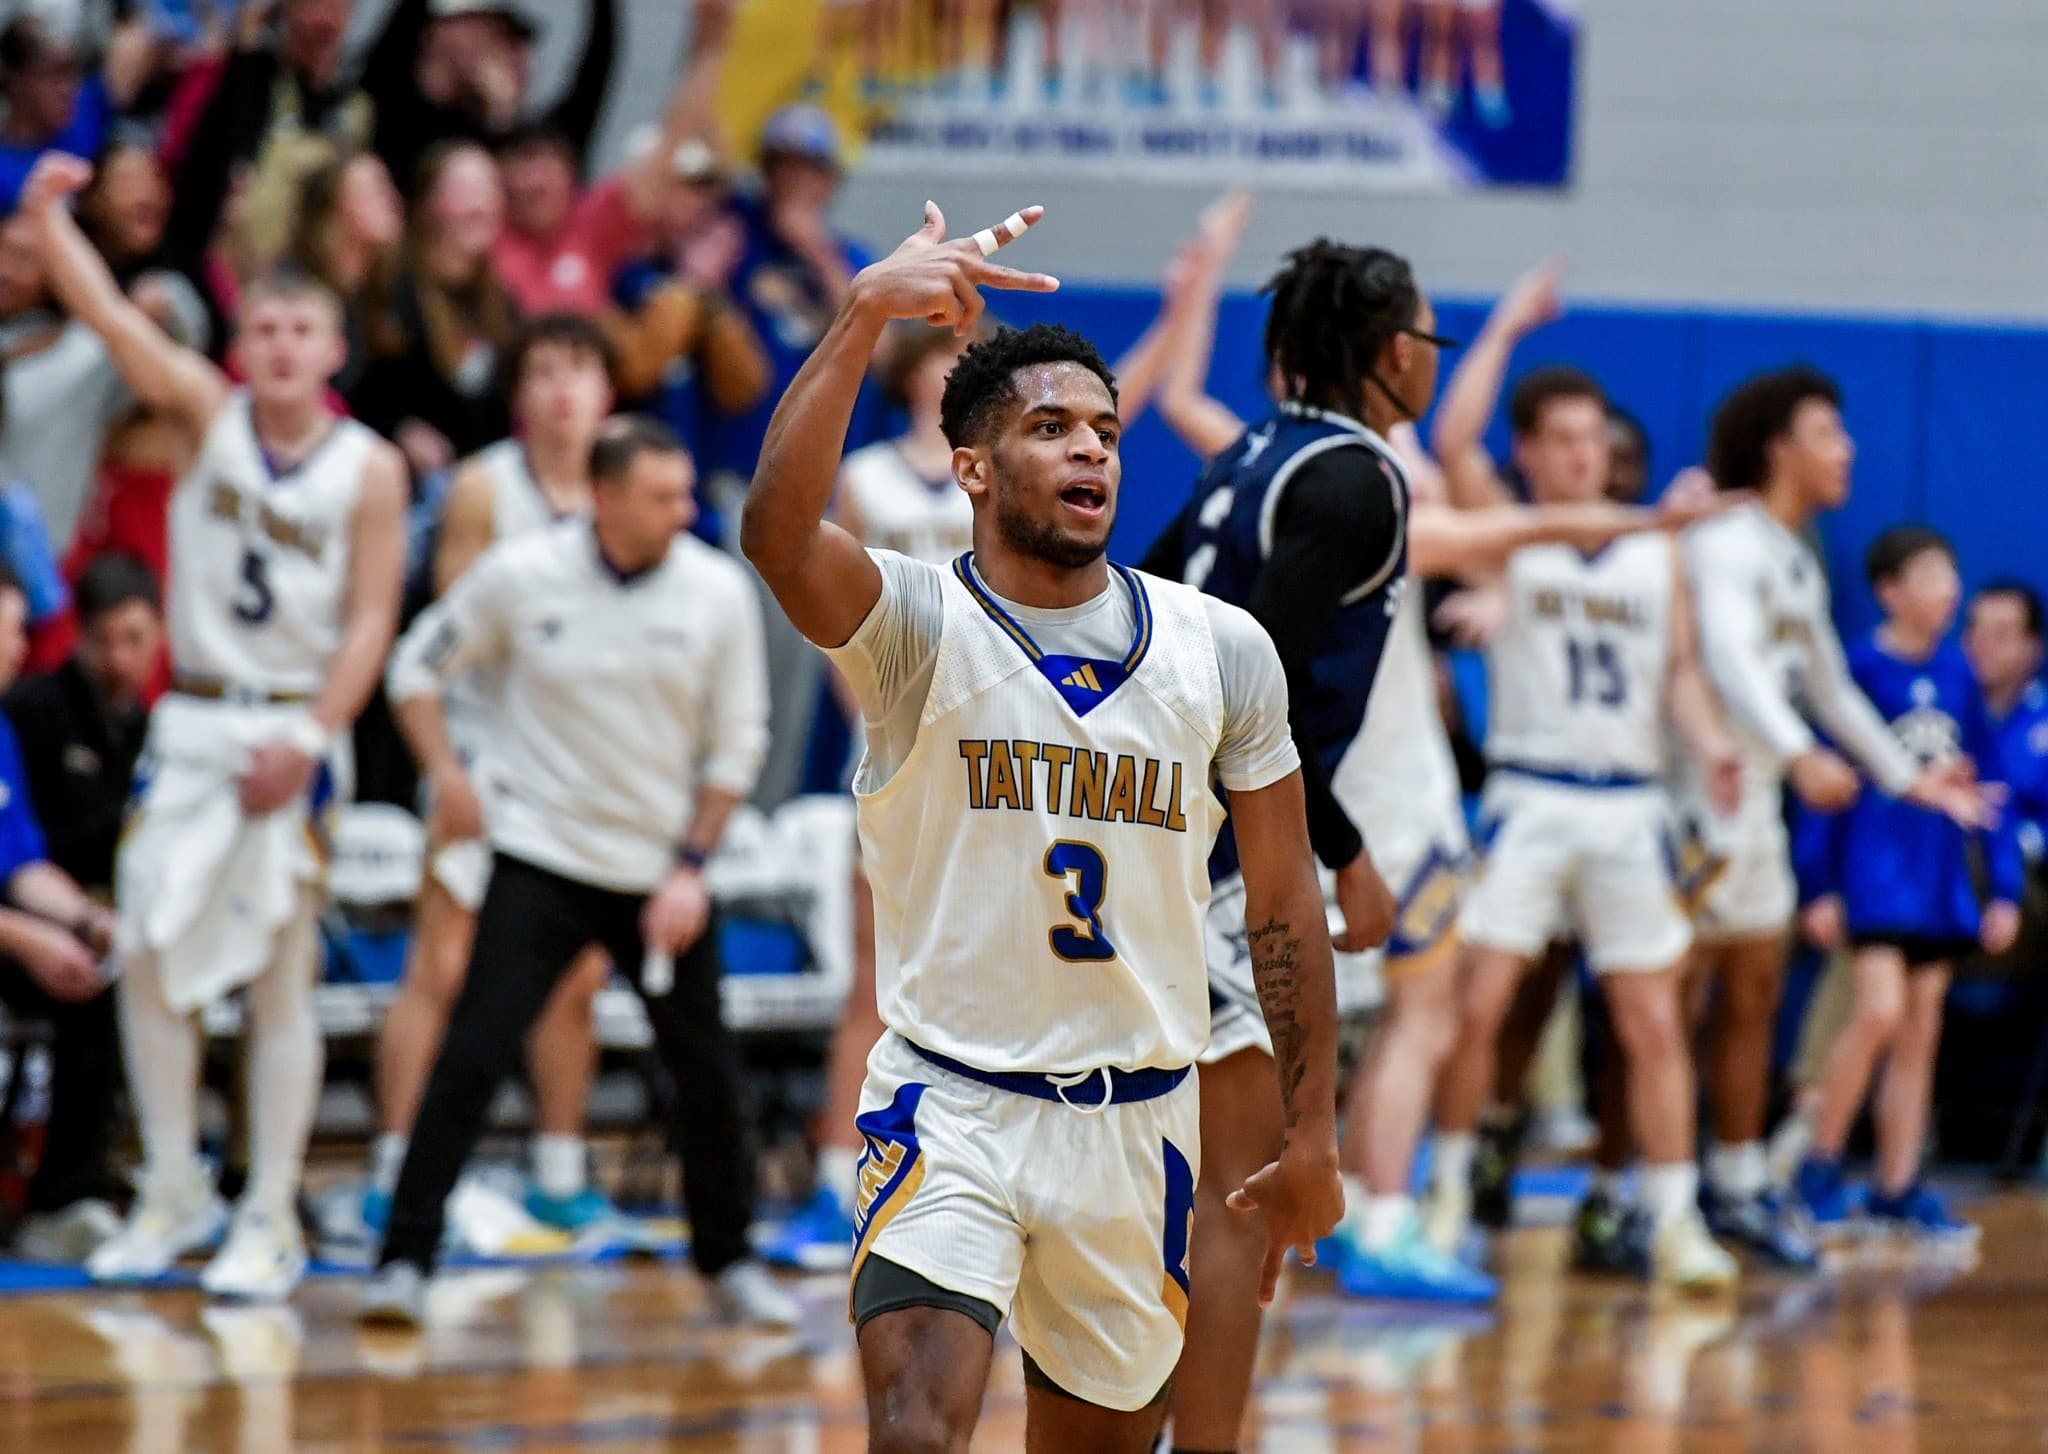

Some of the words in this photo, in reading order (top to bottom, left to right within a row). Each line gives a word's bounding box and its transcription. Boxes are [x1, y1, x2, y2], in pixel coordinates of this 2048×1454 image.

[232, 548, 274, 624] 5
[958, 739, 1187, 832] TATTNALL
[1043, 838, 1118, 963] 3
[853, 1134, 908, 1250] NALL
